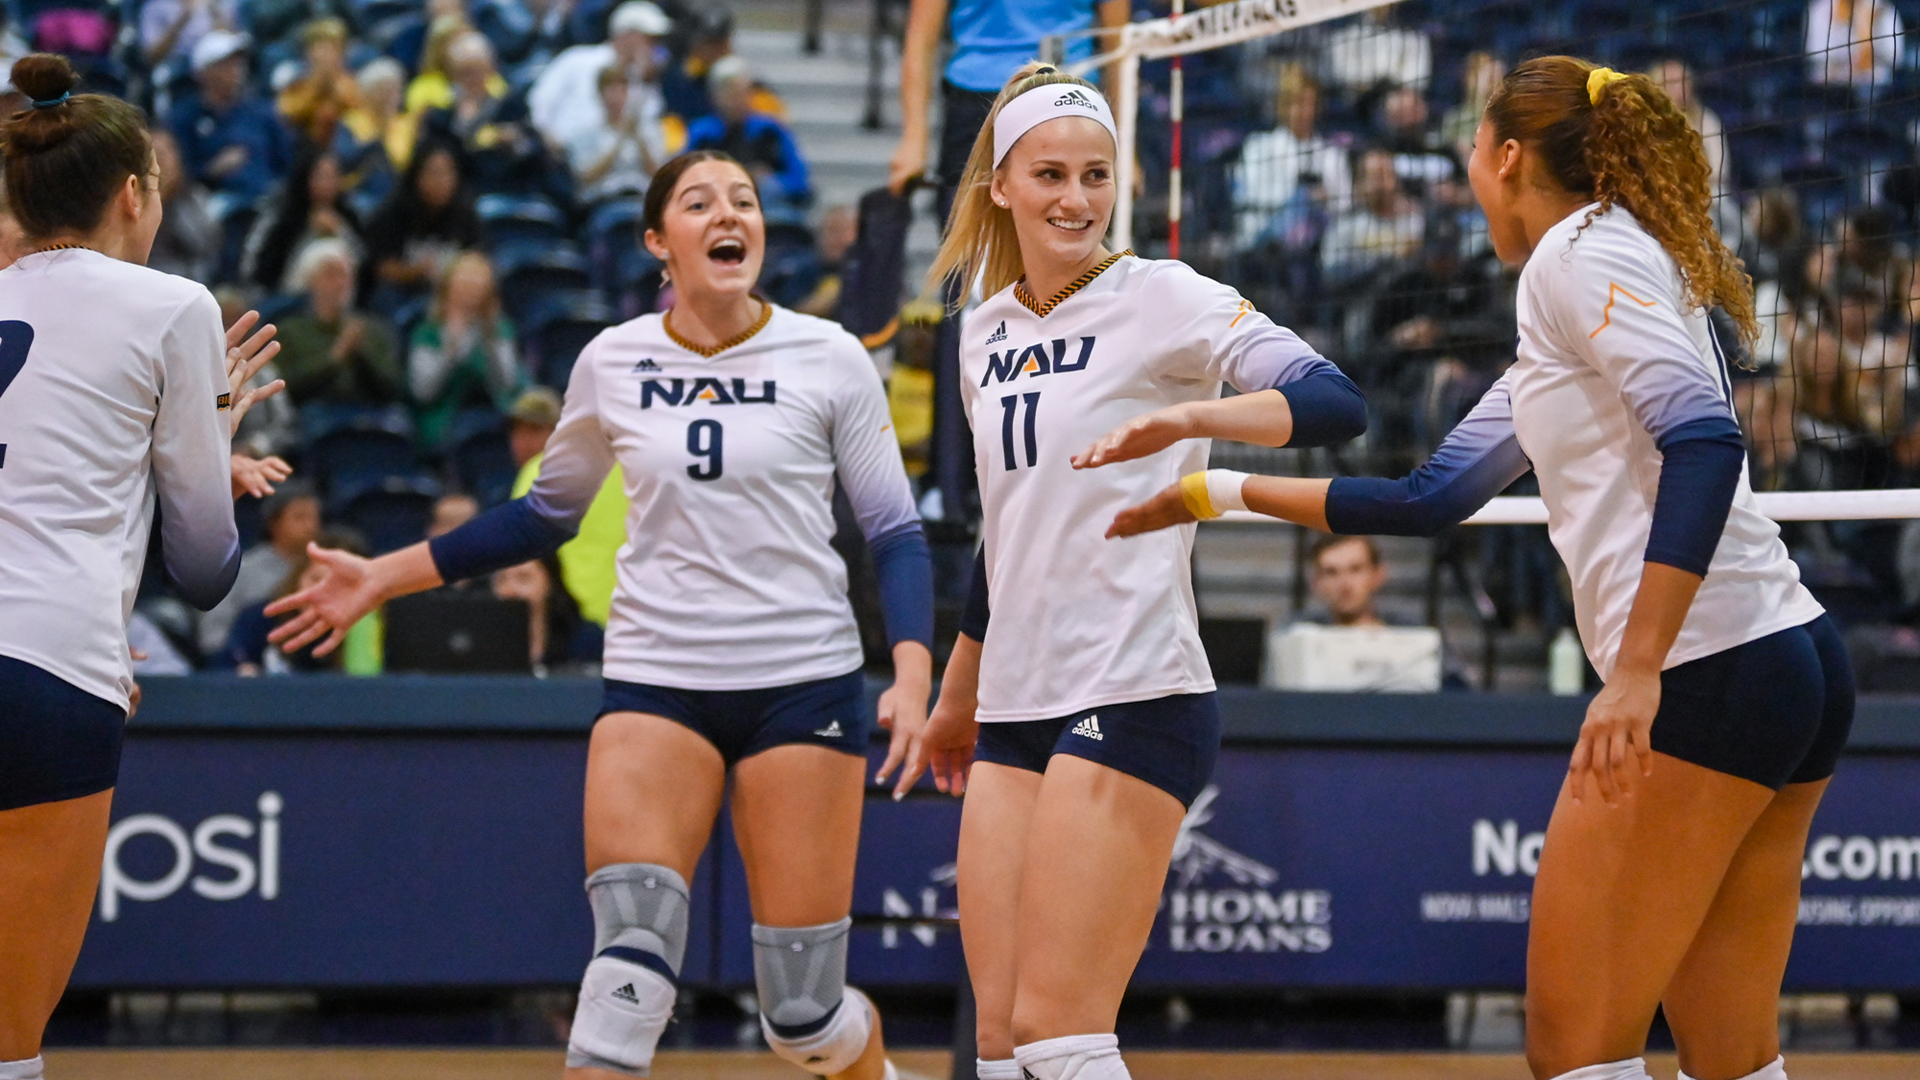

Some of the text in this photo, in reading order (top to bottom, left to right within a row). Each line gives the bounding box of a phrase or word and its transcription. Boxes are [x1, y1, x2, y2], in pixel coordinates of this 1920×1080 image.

[1054, 98, 1098, 111] adidas
[980, 336, 1096, 388] NAU
[640, 377, 776, 410] NAU
[686, 418, 723, 482] 9
[1001, 392, 1041, 471] 11
[1072, 727, 1103, 741] adidas
[101, 791, 282, 922] psi
[1473, 819, 1920, 880] No .com
[1171, 889, 1332, 923] HOME
[1171, 925, 1332, 952] LOANS
